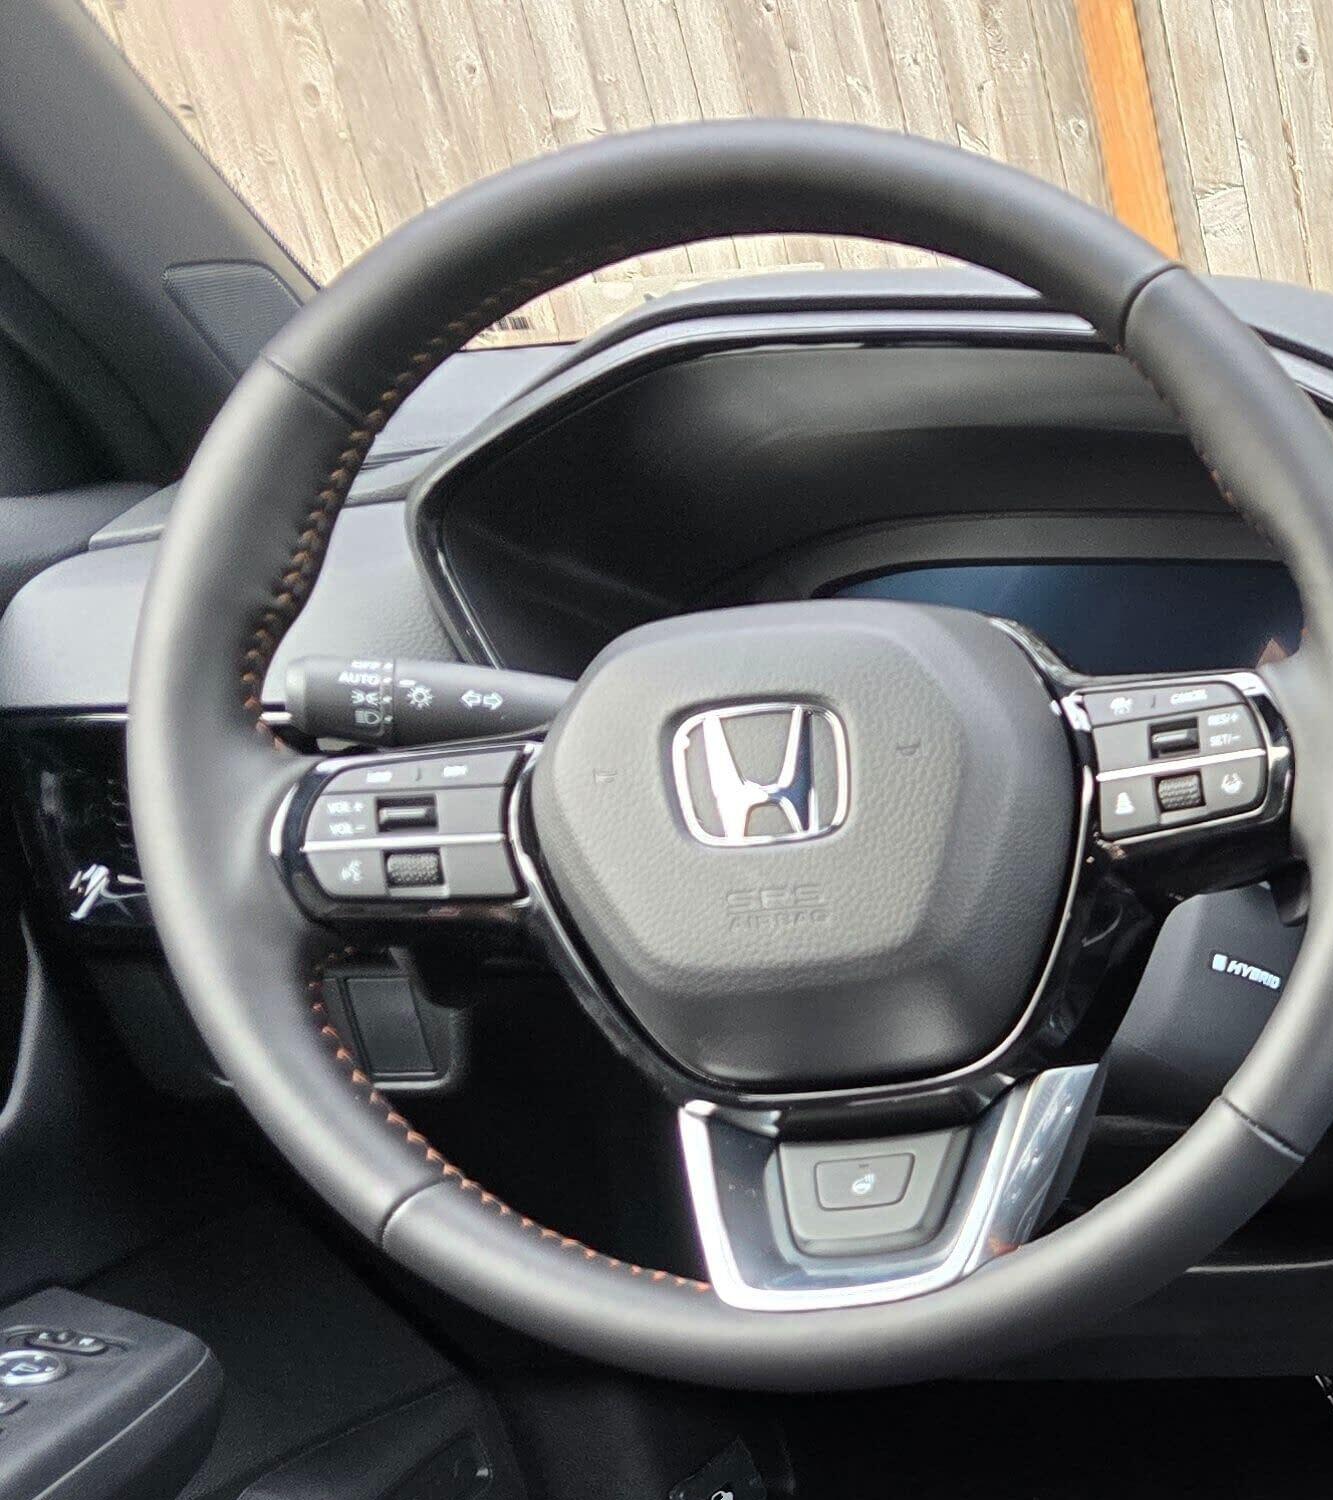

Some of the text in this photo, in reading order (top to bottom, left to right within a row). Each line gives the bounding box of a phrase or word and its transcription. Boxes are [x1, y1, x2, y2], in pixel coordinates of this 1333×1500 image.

[339, 671, 381, 685] AUTO
[327, 801, 351, 814] VOL
[329, 822, 353, 835] VOL
[1227, 960, 1281, 990] HYBRID
